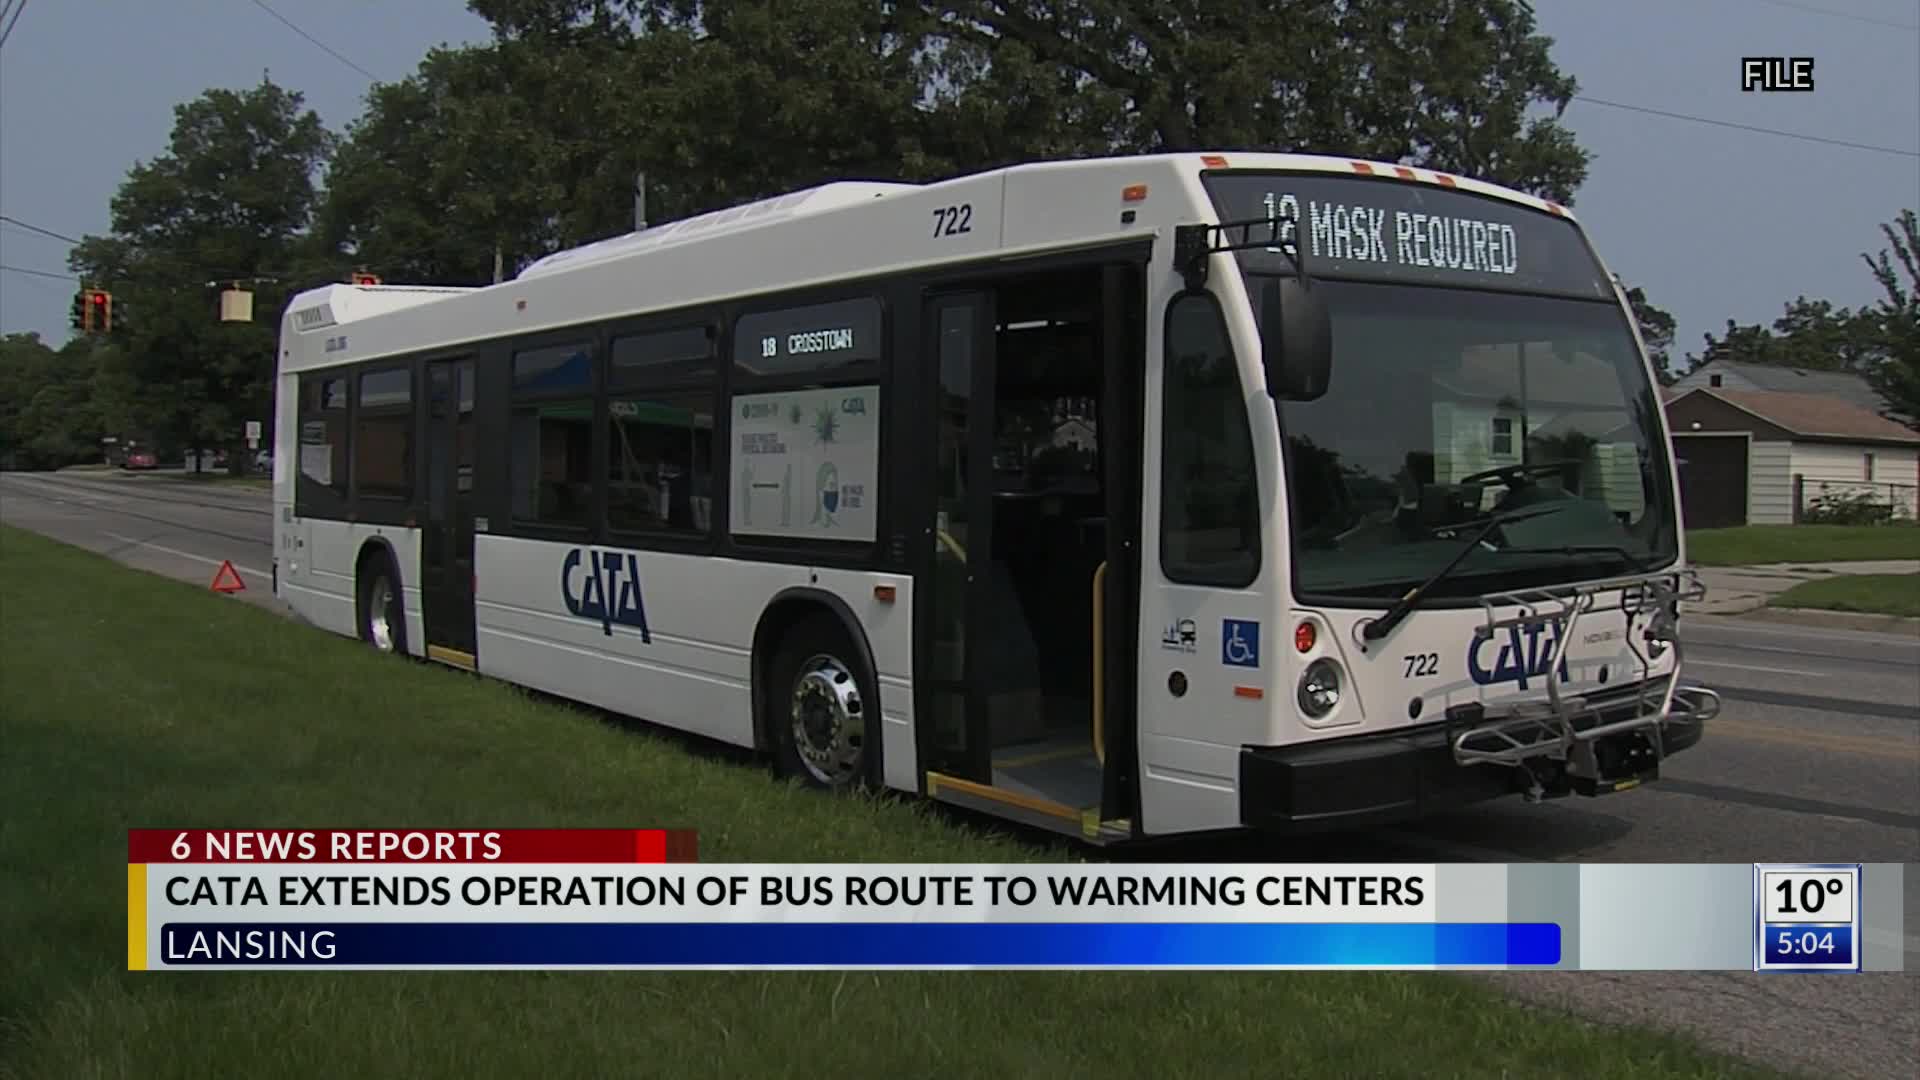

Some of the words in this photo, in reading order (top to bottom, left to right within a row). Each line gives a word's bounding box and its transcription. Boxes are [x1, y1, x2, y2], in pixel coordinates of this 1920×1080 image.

[933, 203, 971, 238] 722
[1310, 201, 1388, 263] MASK
[1396, 211, 1518, 275] REQUIRED
[762, 337, 777, 357] 18
[788, 329, 853, 354] CROSSTOWN
[562, 548, 651, 645] CATA
[1403, 652, 1439, 678] 722
[1468, 618, 1568, 690] CATA
